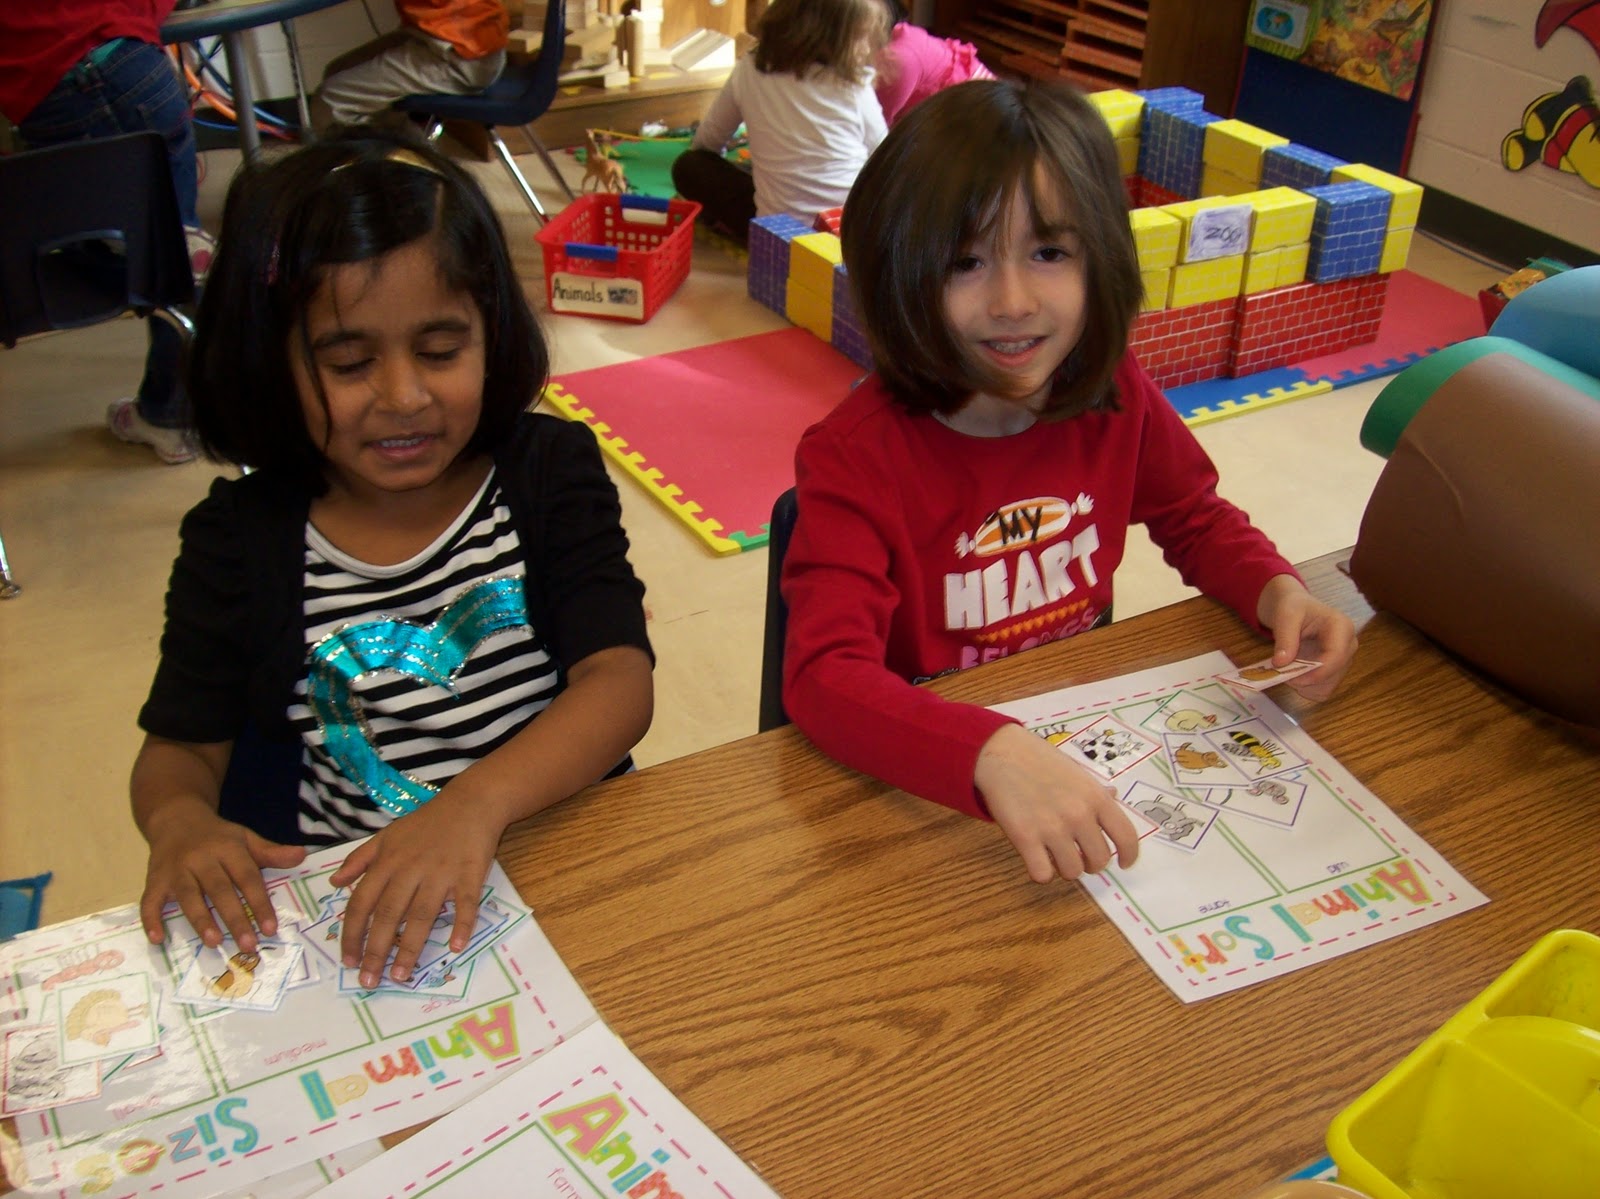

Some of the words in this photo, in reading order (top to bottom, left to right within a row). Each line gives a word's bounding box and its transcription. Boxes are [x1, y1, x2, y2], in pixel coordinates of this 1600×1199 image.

[553, 278, 603, 303] Animals
[998, 505, 1043, 545] MY
[944, 523, 1100, 630] HEART
[1270, 858, 1434, 943] Animal
[1167, 915, 1275, 974] Sort
[264, 1038, 327, 1066] medium
[298, 1000, 520, 1122] Animal
[74, 1097, 259, 1195] Sizes
